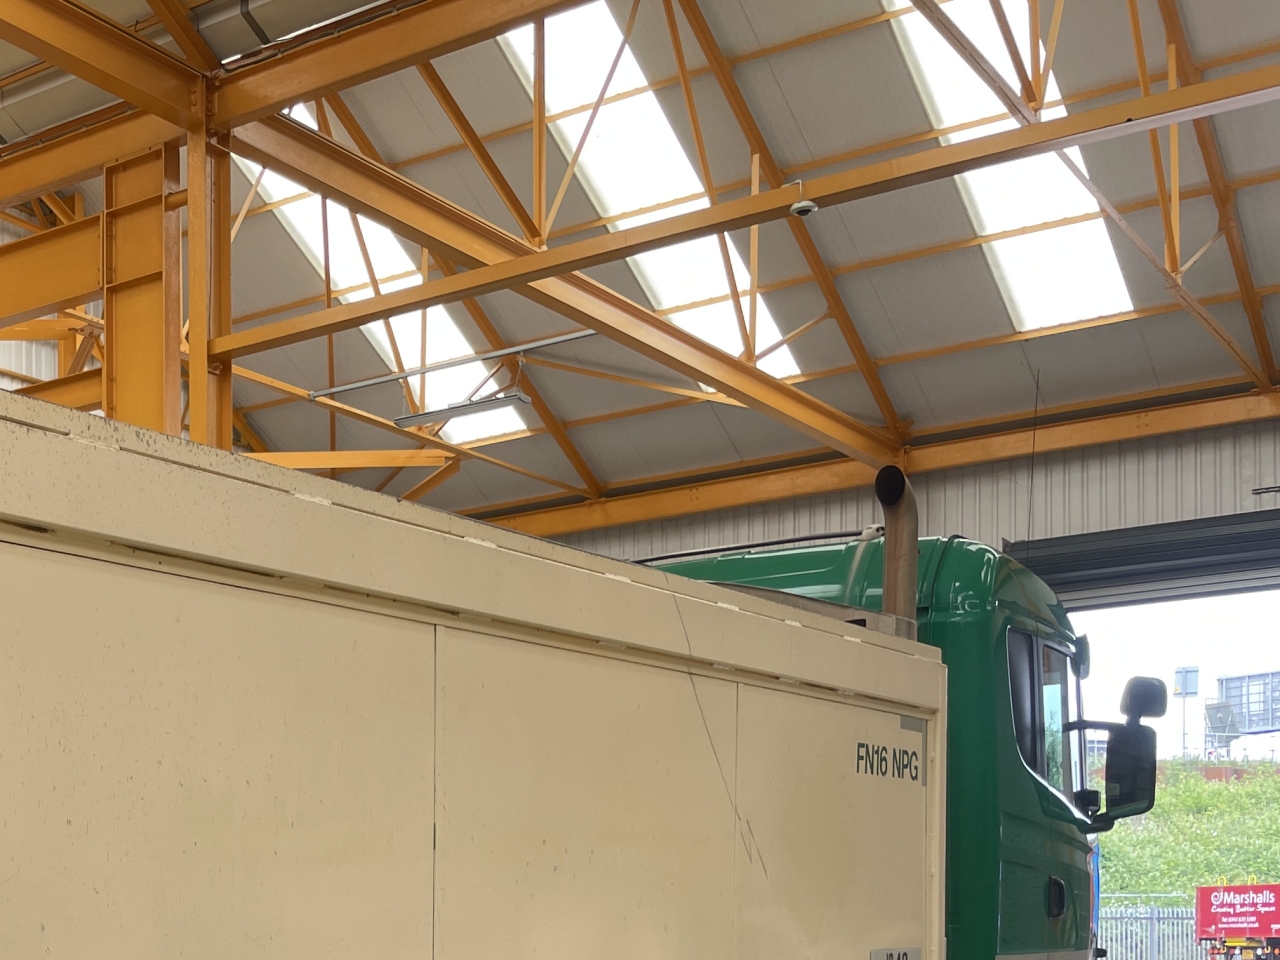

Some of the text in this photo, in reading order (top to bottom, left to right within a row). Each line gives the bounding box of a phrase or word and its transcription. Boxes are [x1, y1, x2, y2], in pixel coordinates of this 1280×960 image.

[856, 742, 919, 781] FN16 NPG
[1223, 890, 1275, 904] Marshalls
[1211, 905, 1234, 914] Creating
[1235, 905, 1255, 913] Better
